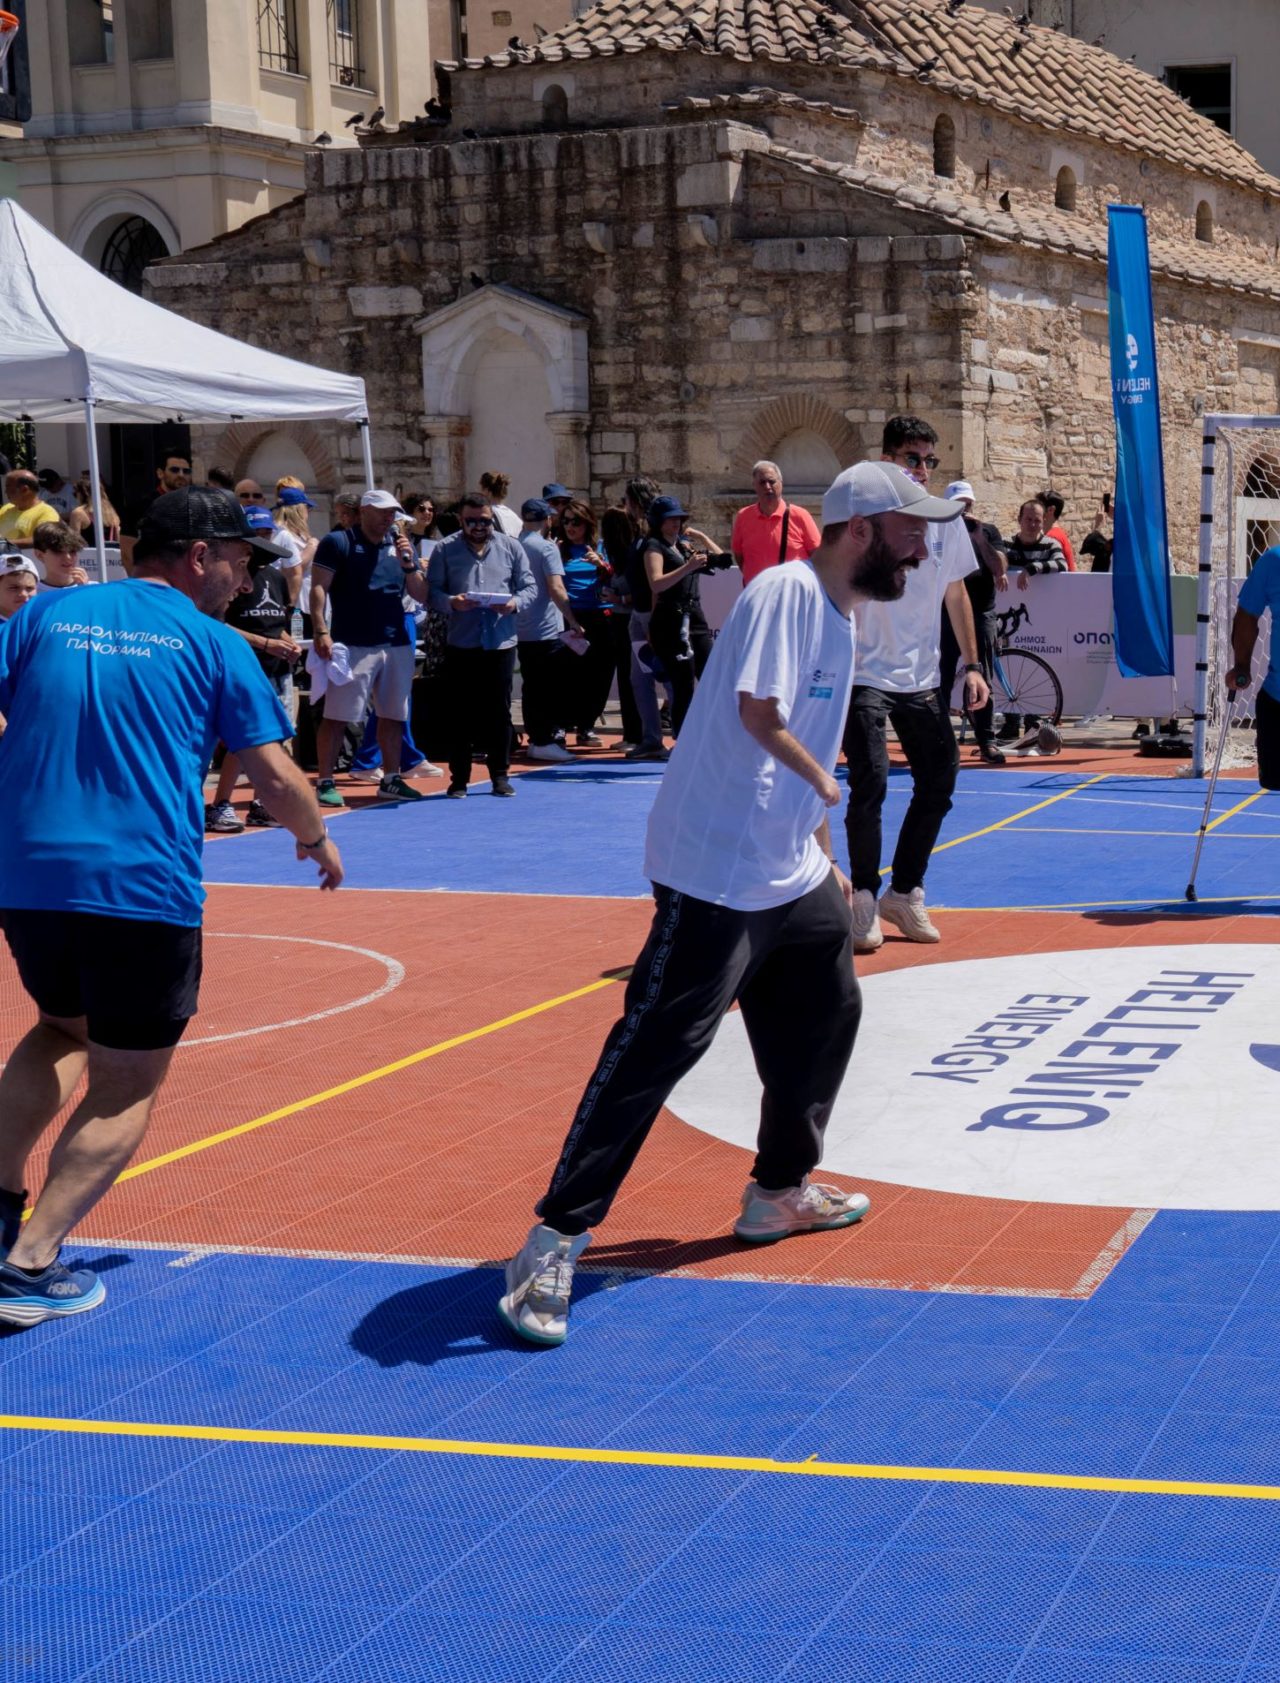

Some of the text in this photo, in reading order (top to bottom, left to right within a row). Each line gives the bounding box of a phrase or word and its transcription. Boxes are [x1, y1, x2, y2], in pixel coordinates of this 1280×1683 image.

[240, 609, 286, 617] JORDA
[50, 622, 184, 650] ΠΑΡΑΟΛΥΜΠΙΑΚΟ
[1014, 636, 1047, 644] ΔΗΜΟΣ
[66, 637, 151, 658] ΠΑΝΟΡΑΜΑ
[910, 993, 1091, 1084] ENERGY
[964, 970, 1256, 1131] HELLENiQ
[47, 1282, 82, 1295] HOKA
